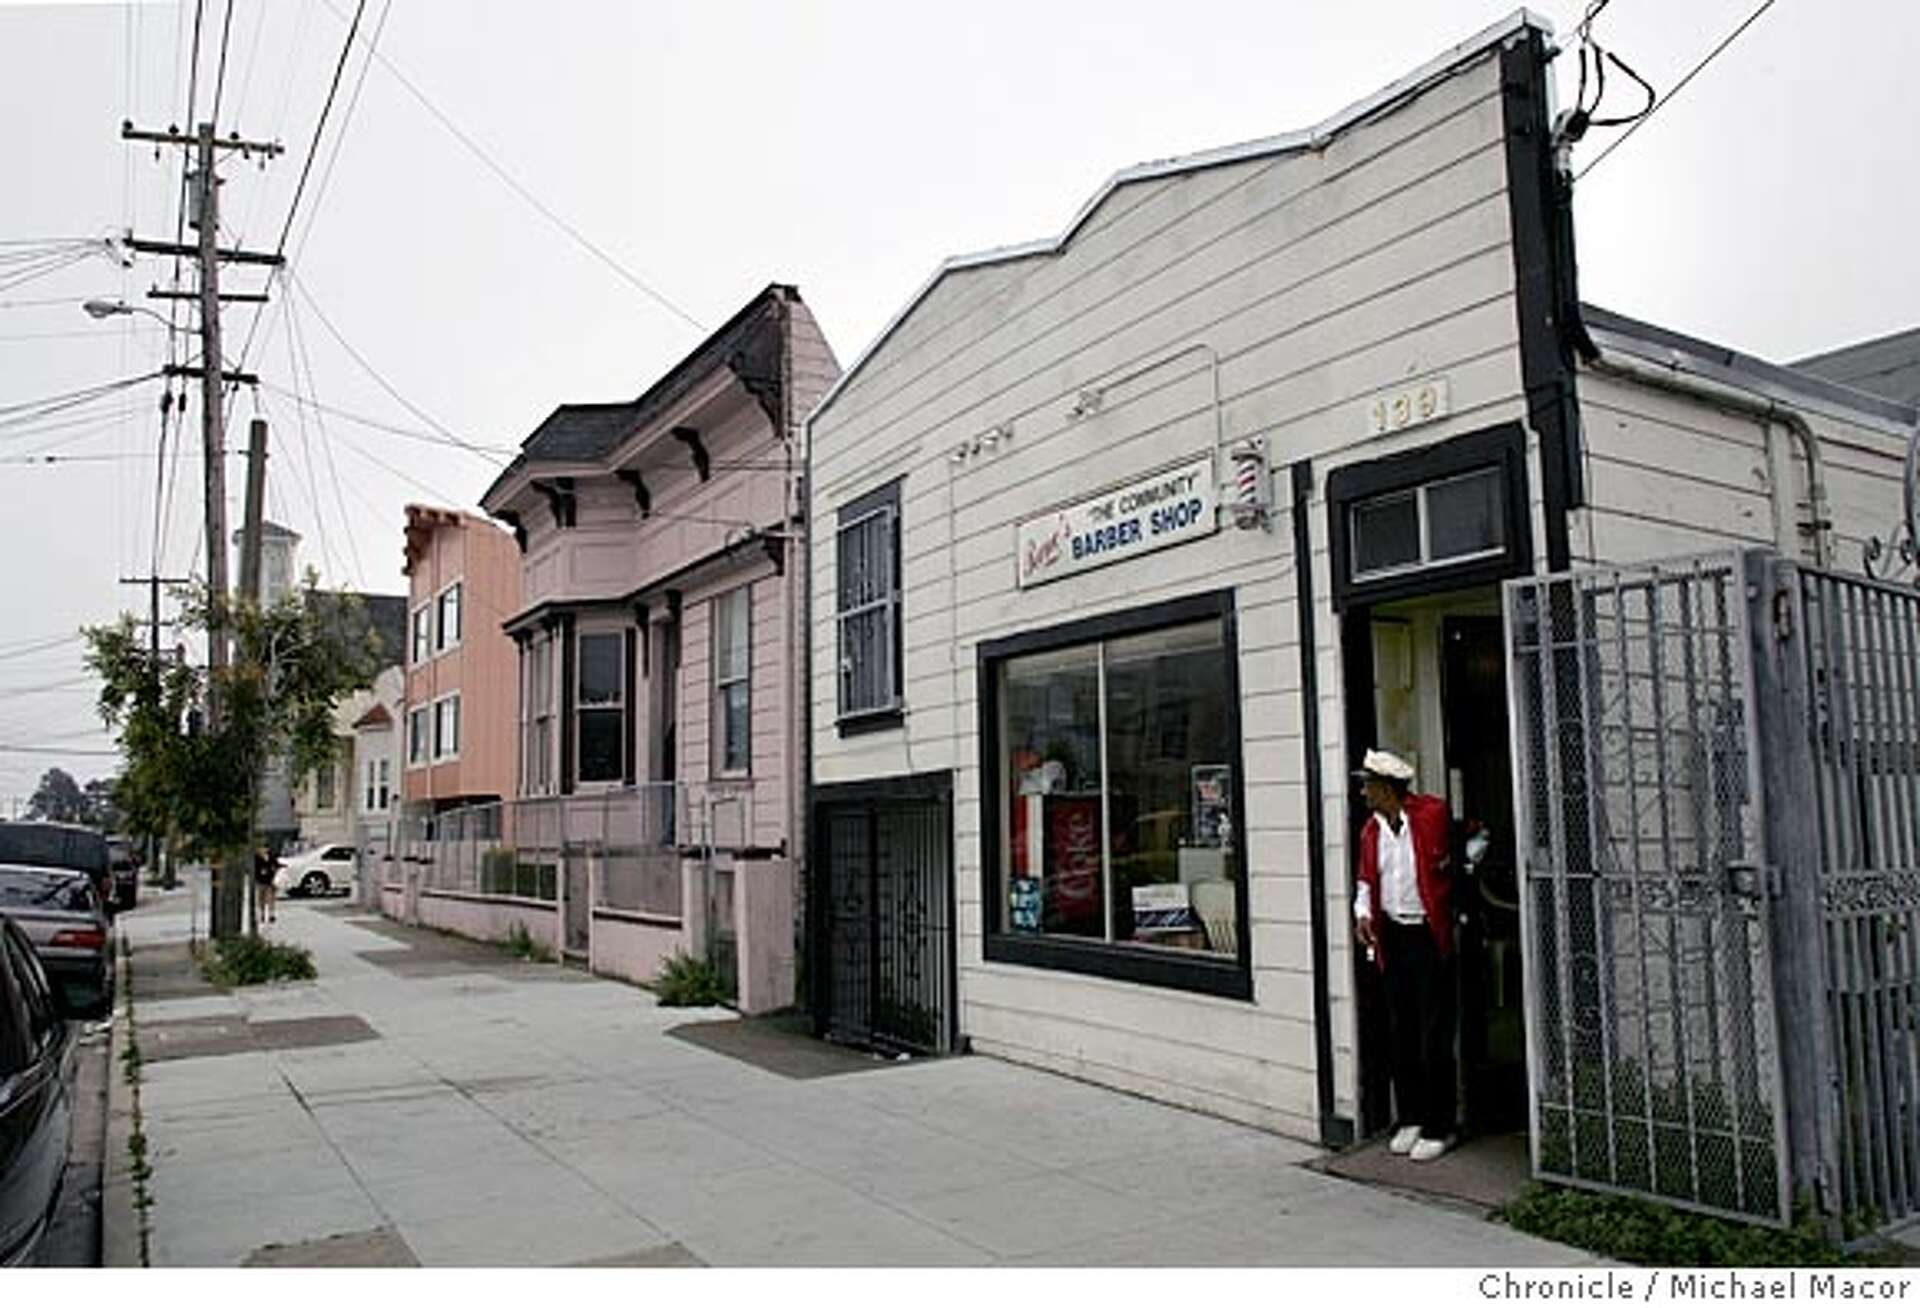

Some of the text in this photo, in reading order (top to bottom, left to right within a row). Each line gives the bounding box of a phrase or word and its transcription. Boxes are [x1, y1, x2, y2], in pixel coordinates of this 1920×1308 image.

[1088, 472, 1198, 522] THE COMMUNITY
[1071, 498, 1203, 560] BARBER SHOP
